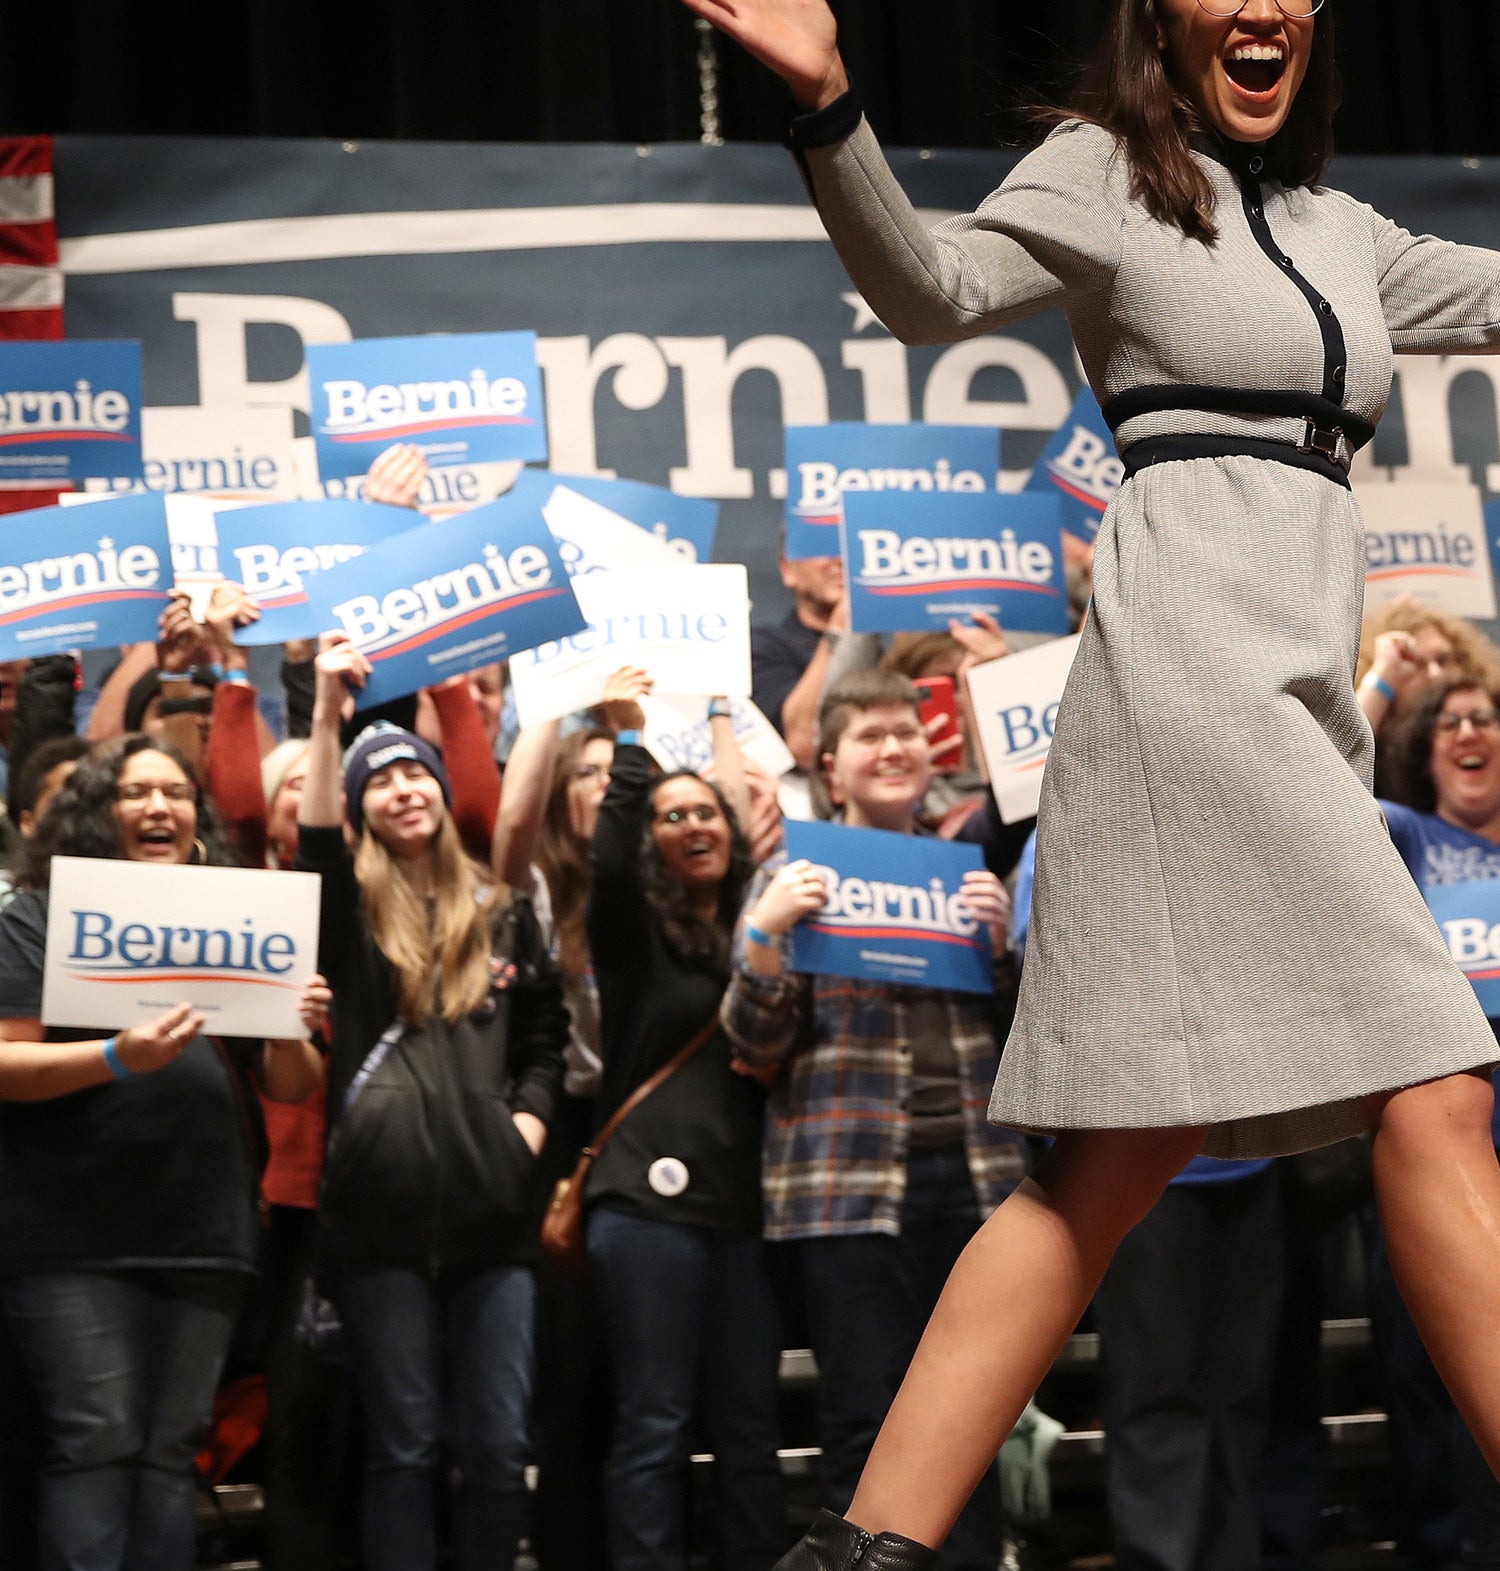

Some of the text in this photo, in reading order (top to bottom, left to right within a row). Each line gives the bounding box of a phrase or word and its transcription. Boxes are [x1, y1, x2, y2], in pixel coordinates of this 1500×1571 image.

[0, 380, 129, 431] rnie
[323, 367, 528, 429] Bernie
[108, 447, 277, 493] ernie
[0, 536, 160, 606] ernie
[857, 528, 1053, 584] Bernie
[1366, 523, 1474, 567] ernie
[332, 543, 551, 648] Bernie
[69, 909, 297, 975] Bernie
